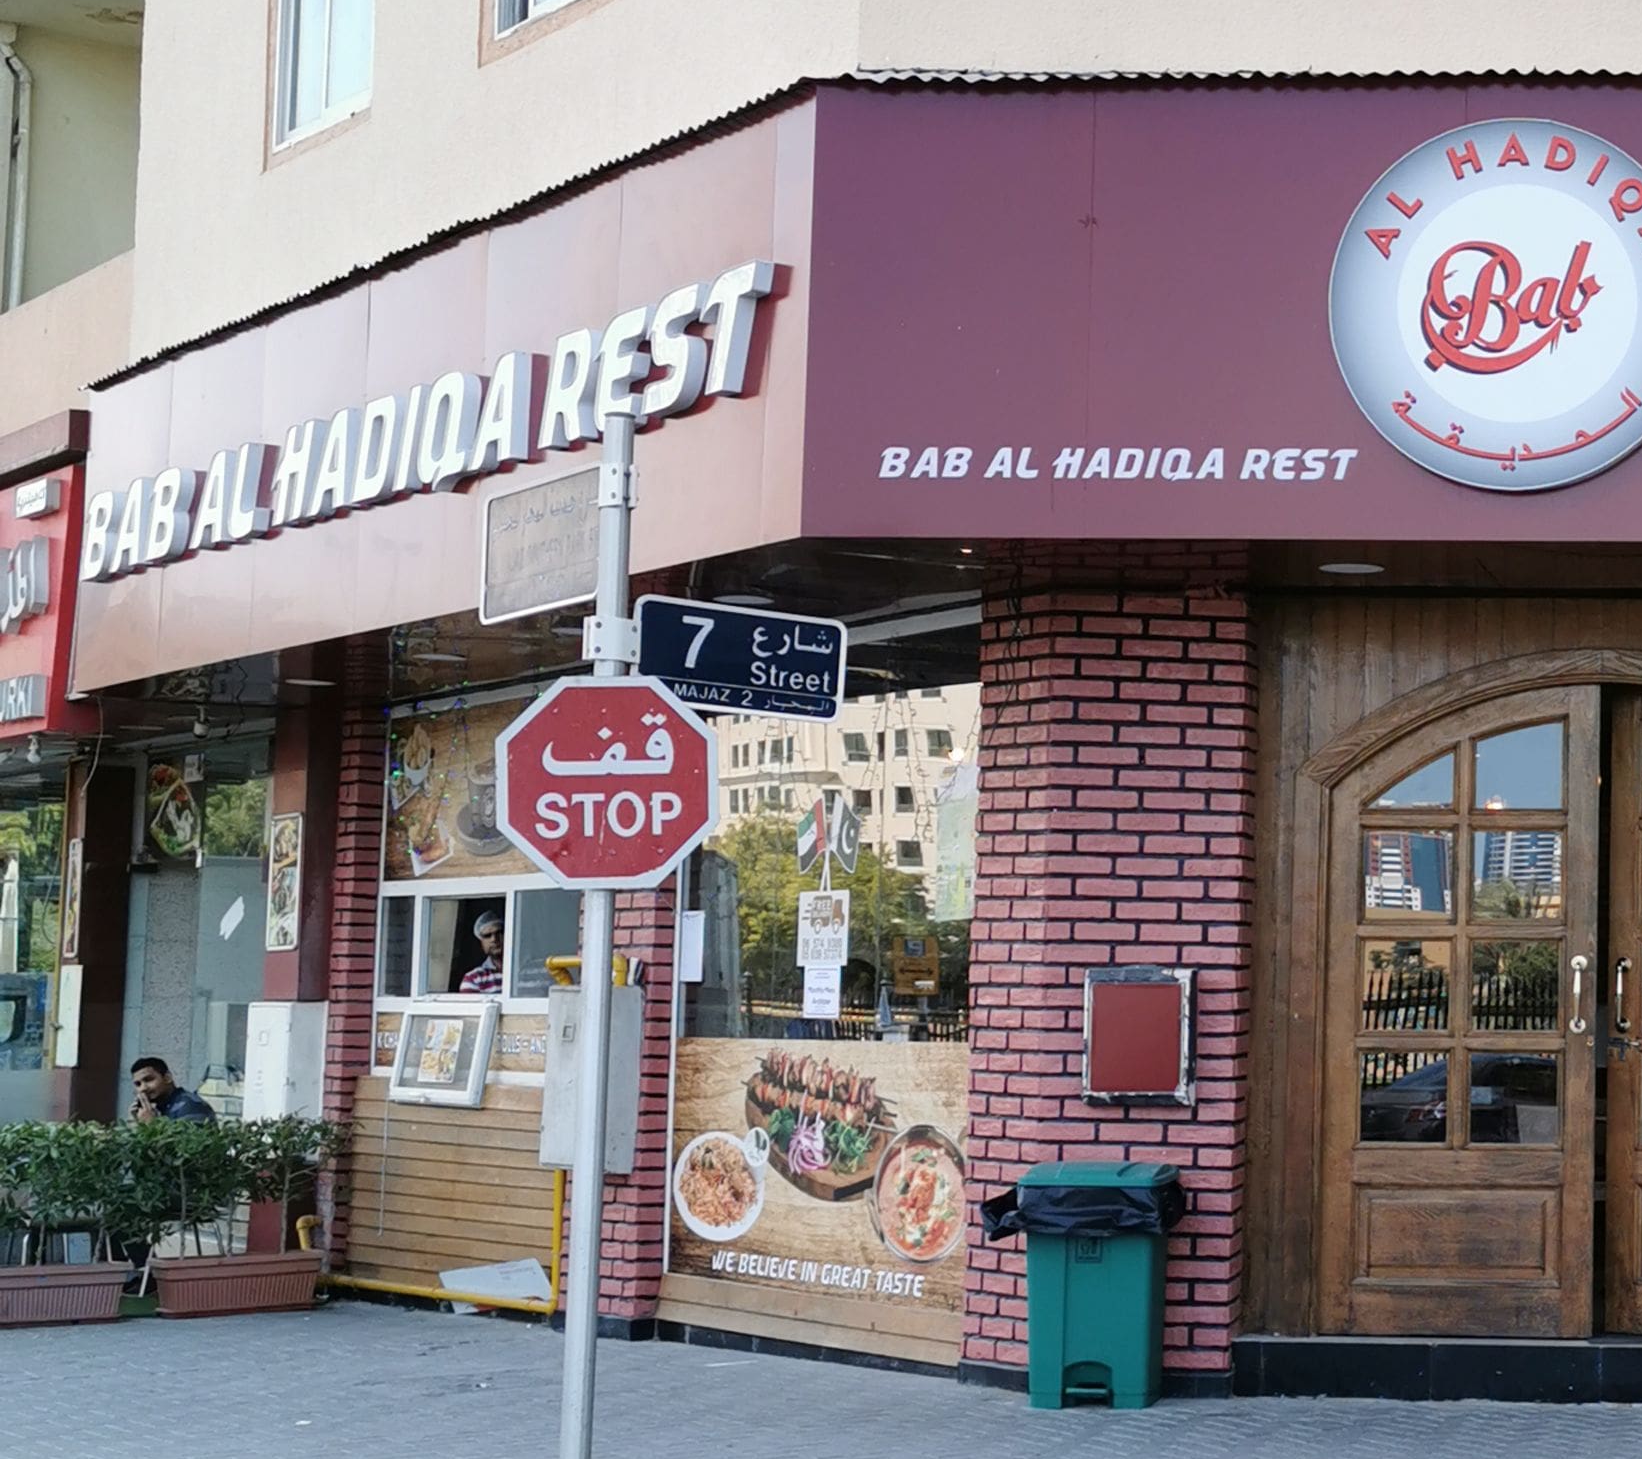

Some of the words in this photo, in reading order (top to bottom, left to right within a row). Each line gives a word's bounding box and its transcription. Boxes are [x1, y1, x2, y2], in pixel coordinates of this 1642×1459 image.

[1364, 191, 1423, 260] AL
[1423, 240, 1604, 373] Bab
[81, 467, 196, 581] BAB
[189, 442, 273, 545] AL
[271, 352, 531, 529] HADIQA
[538, 259, 775, 451] REST
[879, 446, 972, 479] BAB
[984, 446, 1039, 479] AL
[1051, 447, 1225, 482] HADIQA
[1239, 448, 1359, 481] REST
[682, 614, 715, 670] 7
[751, 624, 834, 658] شارع
[673, 682, 731, 703] MAJAZ
[740, 690, 754, 707] 2
[750, 661, 831, 693] Street
[541, 712, 675, 777] قف
[534, 790, 683, 840] STOP
[711, 1249, 736, 1272] WE
[738, 1253, 798, 1281] BELIEVE
[799, 1259, 819, 1283] IN
[820, 1263, 872, 1290] GREAT
[875, 1269, 926, 1298] TASTE
